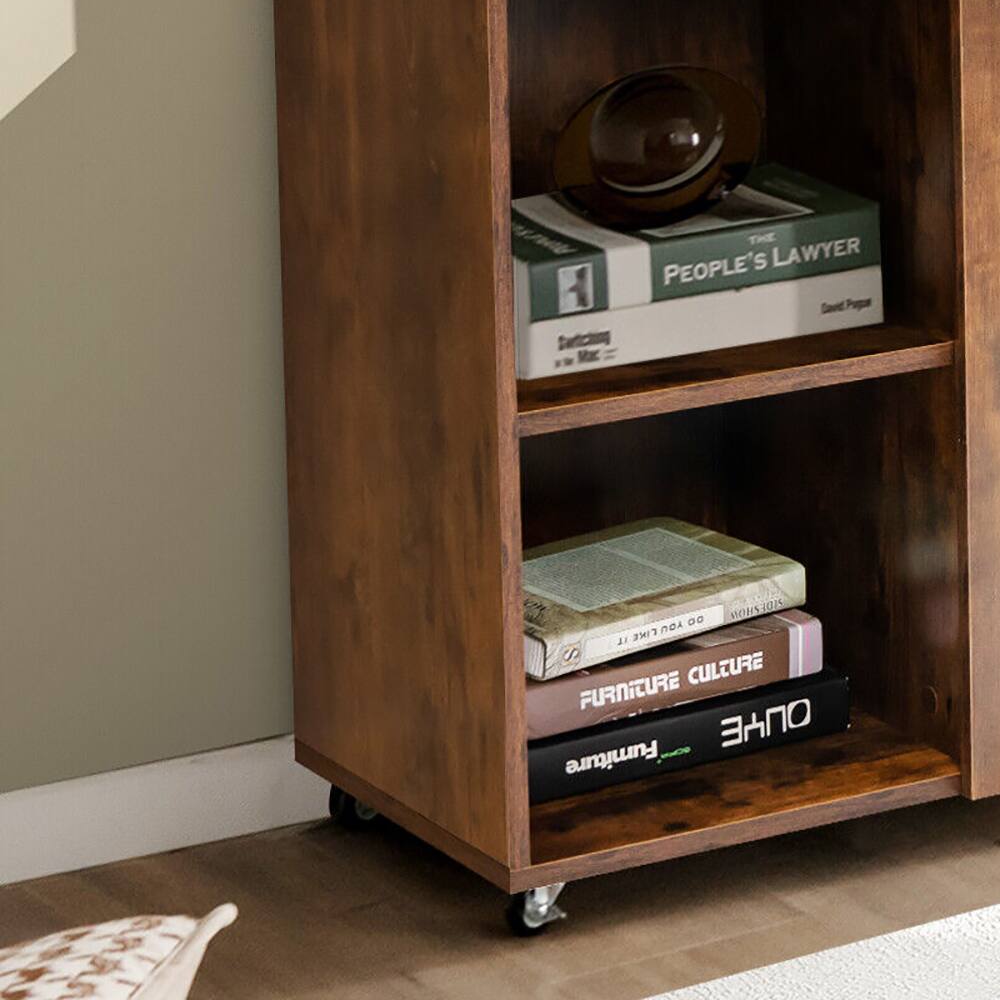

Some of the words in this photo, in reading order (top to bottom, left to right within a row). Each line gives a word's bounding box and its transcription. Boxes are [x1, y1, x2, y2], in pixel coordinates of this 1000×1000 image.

[748, 231, 777, 245] THE
[663, 251, 768, 286] PEOPLE'S
[772, 237, 861, 268] LAWYER
[730, 598, 785, 621] SIDESHOW
[632, 628, 658, 642] LIKE
[660, 620, 684, 634] YOU
[579, 669, 682, 711] FURNITURE
[687, 651, 765, 686] CULTURE
[565, 739, 659, 775] Furniture
